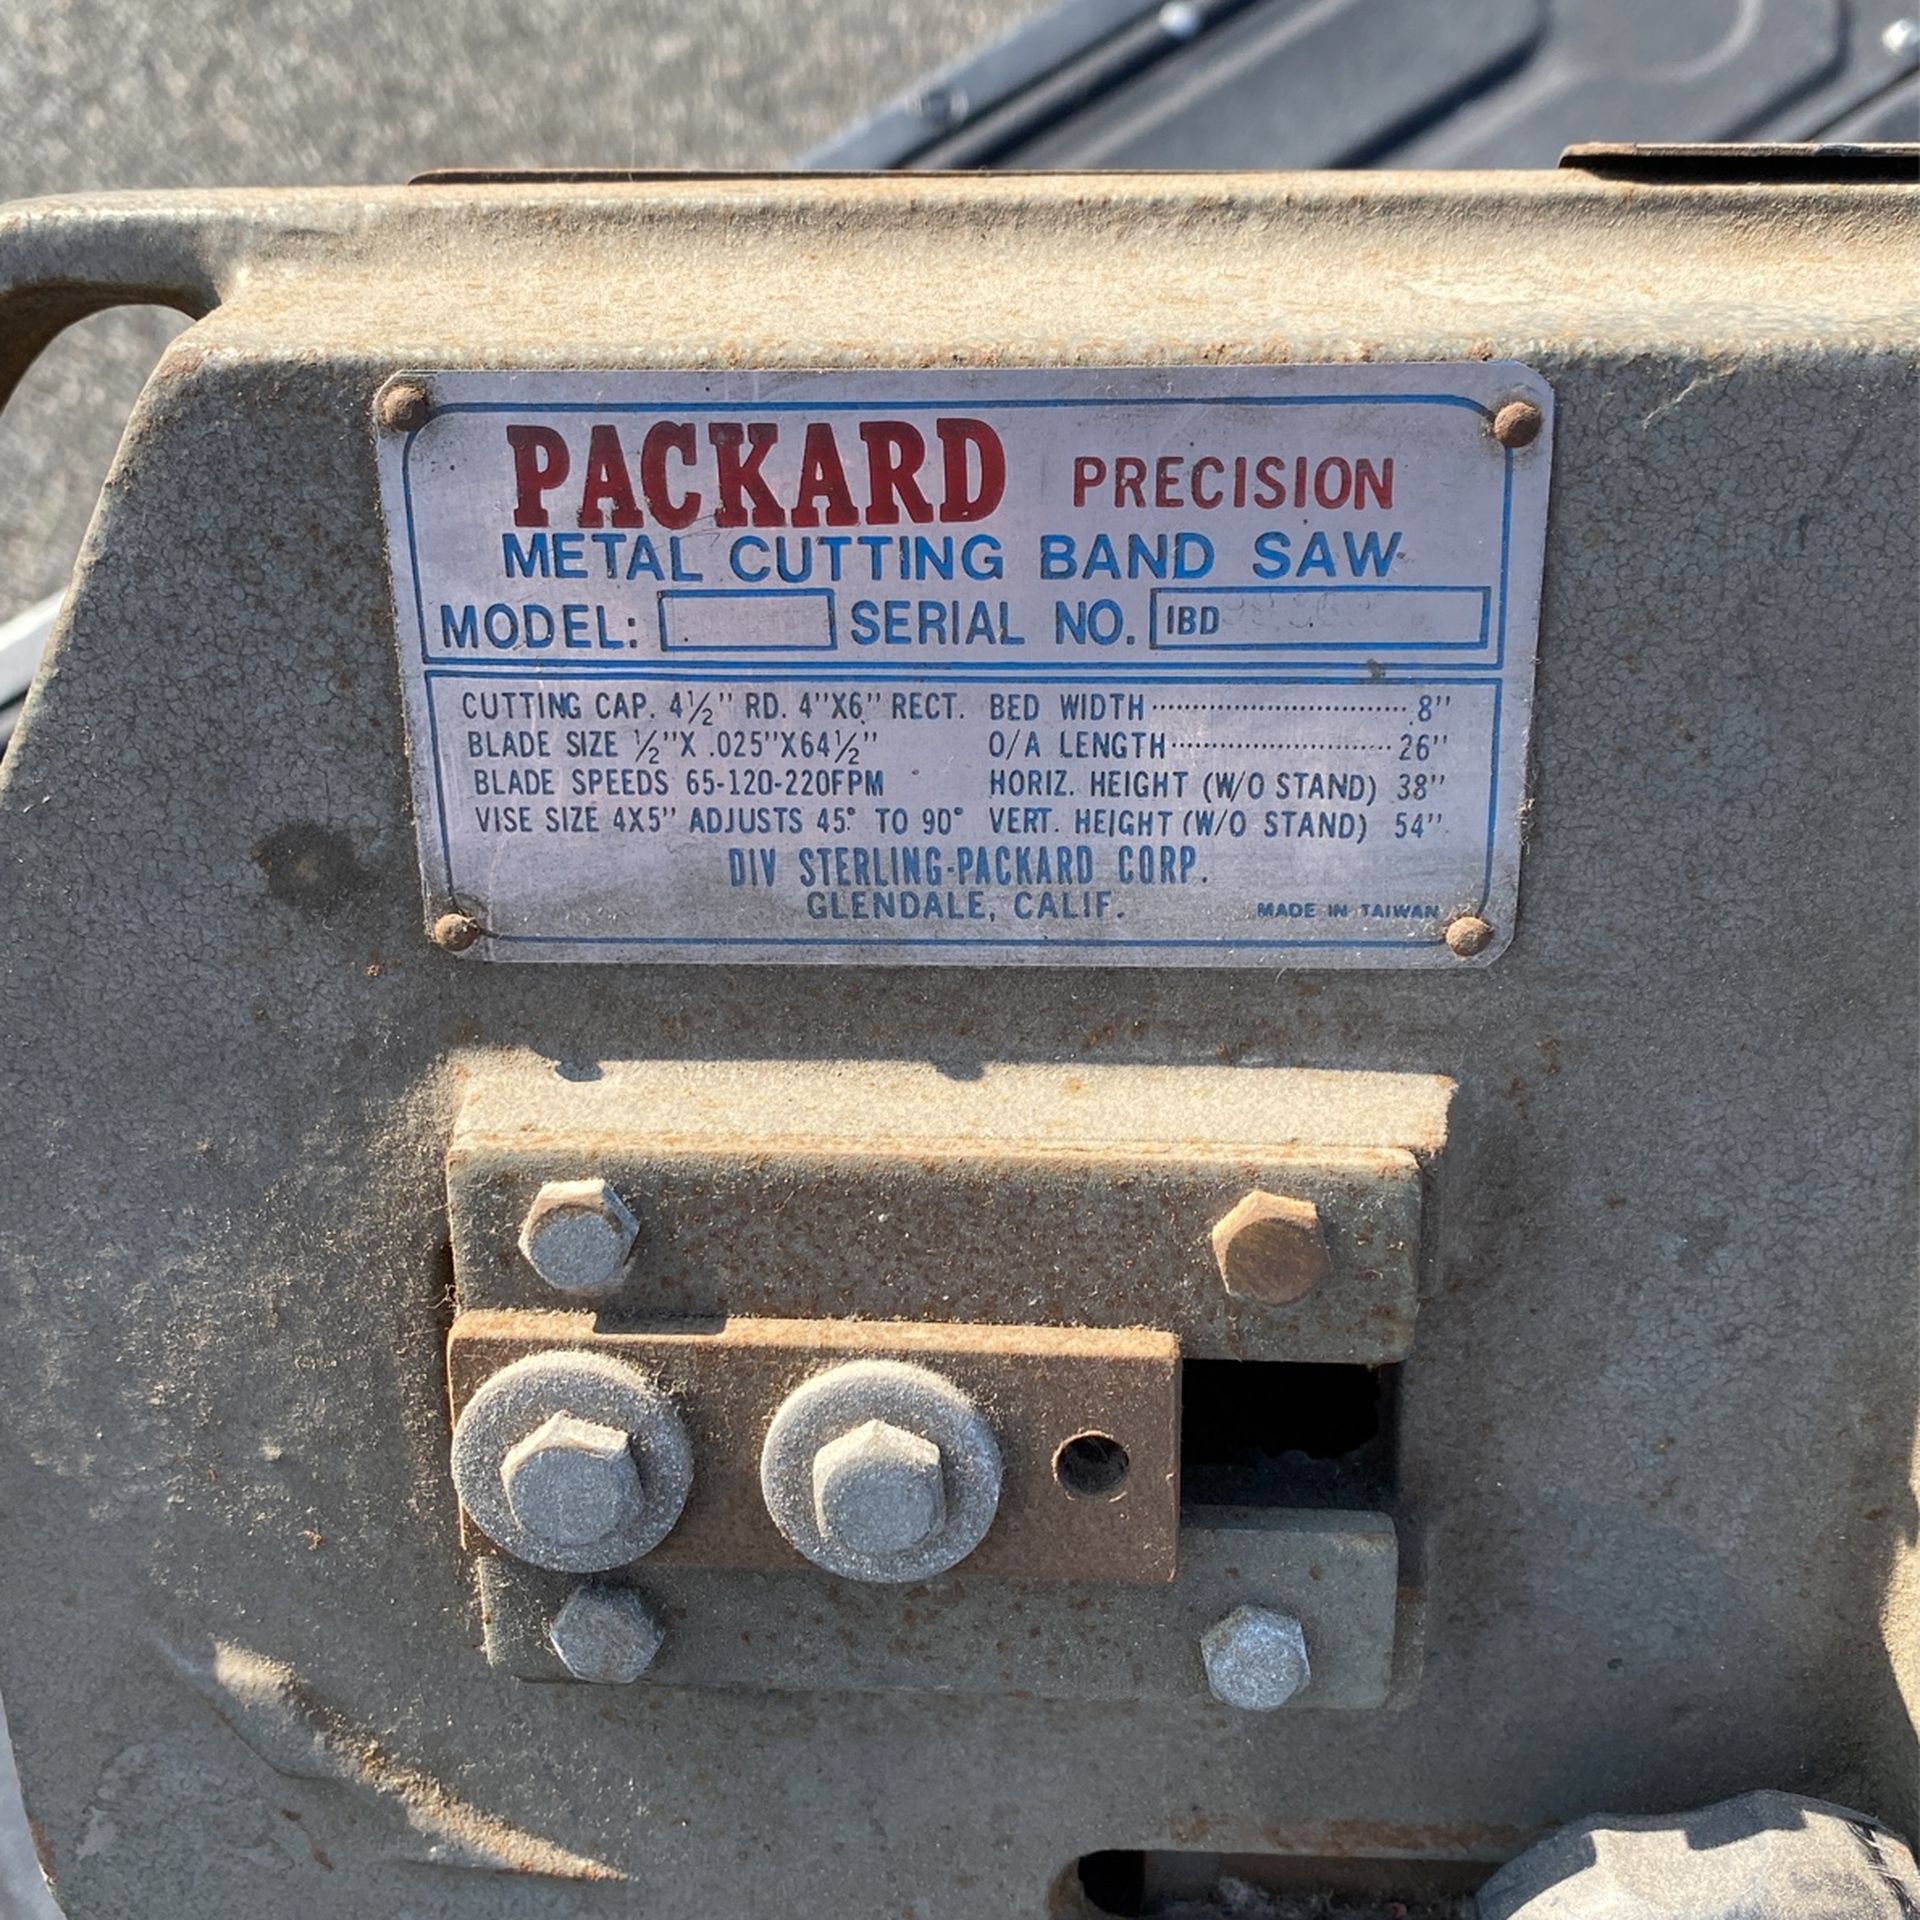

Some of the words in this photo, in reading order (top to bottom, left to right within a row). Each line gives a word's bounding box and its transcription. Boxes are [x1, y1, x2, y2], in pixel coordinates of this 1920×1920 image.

[507, 418, 1006, 530] PACKARD
[1073, 456, 1394, 510] PRECISION
[502, 532, 703, 582] METAL
[729, 534, 1003, 582] CUTTING
[1040, 533, 1215, 580] BAND
[1252, 531, 1402, 580] SAW
[440, 600, 637, 649] MODEL:
[850, 600, 1025, 646] SERIAL
[1055, 600, 1136, 645] NO.
[462, 692, 581, 719] CUTTING
[596, 692, 655, 719] CAP.
[745, 692, 787, 719] RD.
[892, 692, 965, 720] RECT.
[990, 694, 1039, 721] BED
[468, 731, 550, 757] BLADE
[566, 731, 618, 757] SIZE
[989, 729, 1040, 760] O/A
[1398, 734, 1447, 761] 26"
[474, 769, 555, 795] BLADE
[572, 769, 669, 795] SPEEDS
[687, 769, 884, 796] 65-120-220FPM
[990, 770, 1074, 797] HORIZ.
[1091, 770, 1188, 798] HEIGHT
[1203, 771, 1264, 803] (W/O
[1276, 772, 1376, 806] STAND)
[1397, 774, 1445, 801] 38"
[475, 807, 533, 833] VISE
[546, 807, 600, 833] SIZE
[613, 807, 676, 833] 4X5"
[689, 807, 803, 834] ADJUSTS
[875, 808, 908, 835] TO
[922, 807, 963, 835] 90°
[990, 807, 1059, 834] VERT.
[1075, 808, 1172, 837] HEIGHT
[1183, 809, 1246, 837] (W/O
[1264, 811, 1367, 844] STAND)
[1395, 812, 1441, 839] 54"
[729, 848, 776, 887] DIV
[799, 845, 1094, 887] STERLING-PACKARD
[1118, 845, 1208, 884] CORP.
[807, 891, 996, 922] GLENDALE,
[1014, 891, 1125, 920] CALIF.
[1257, 903, 1316, 918] MADE
[1328, 904, 1347, 918] IN
[1361, 903, 1440, 919] TAIWAN
